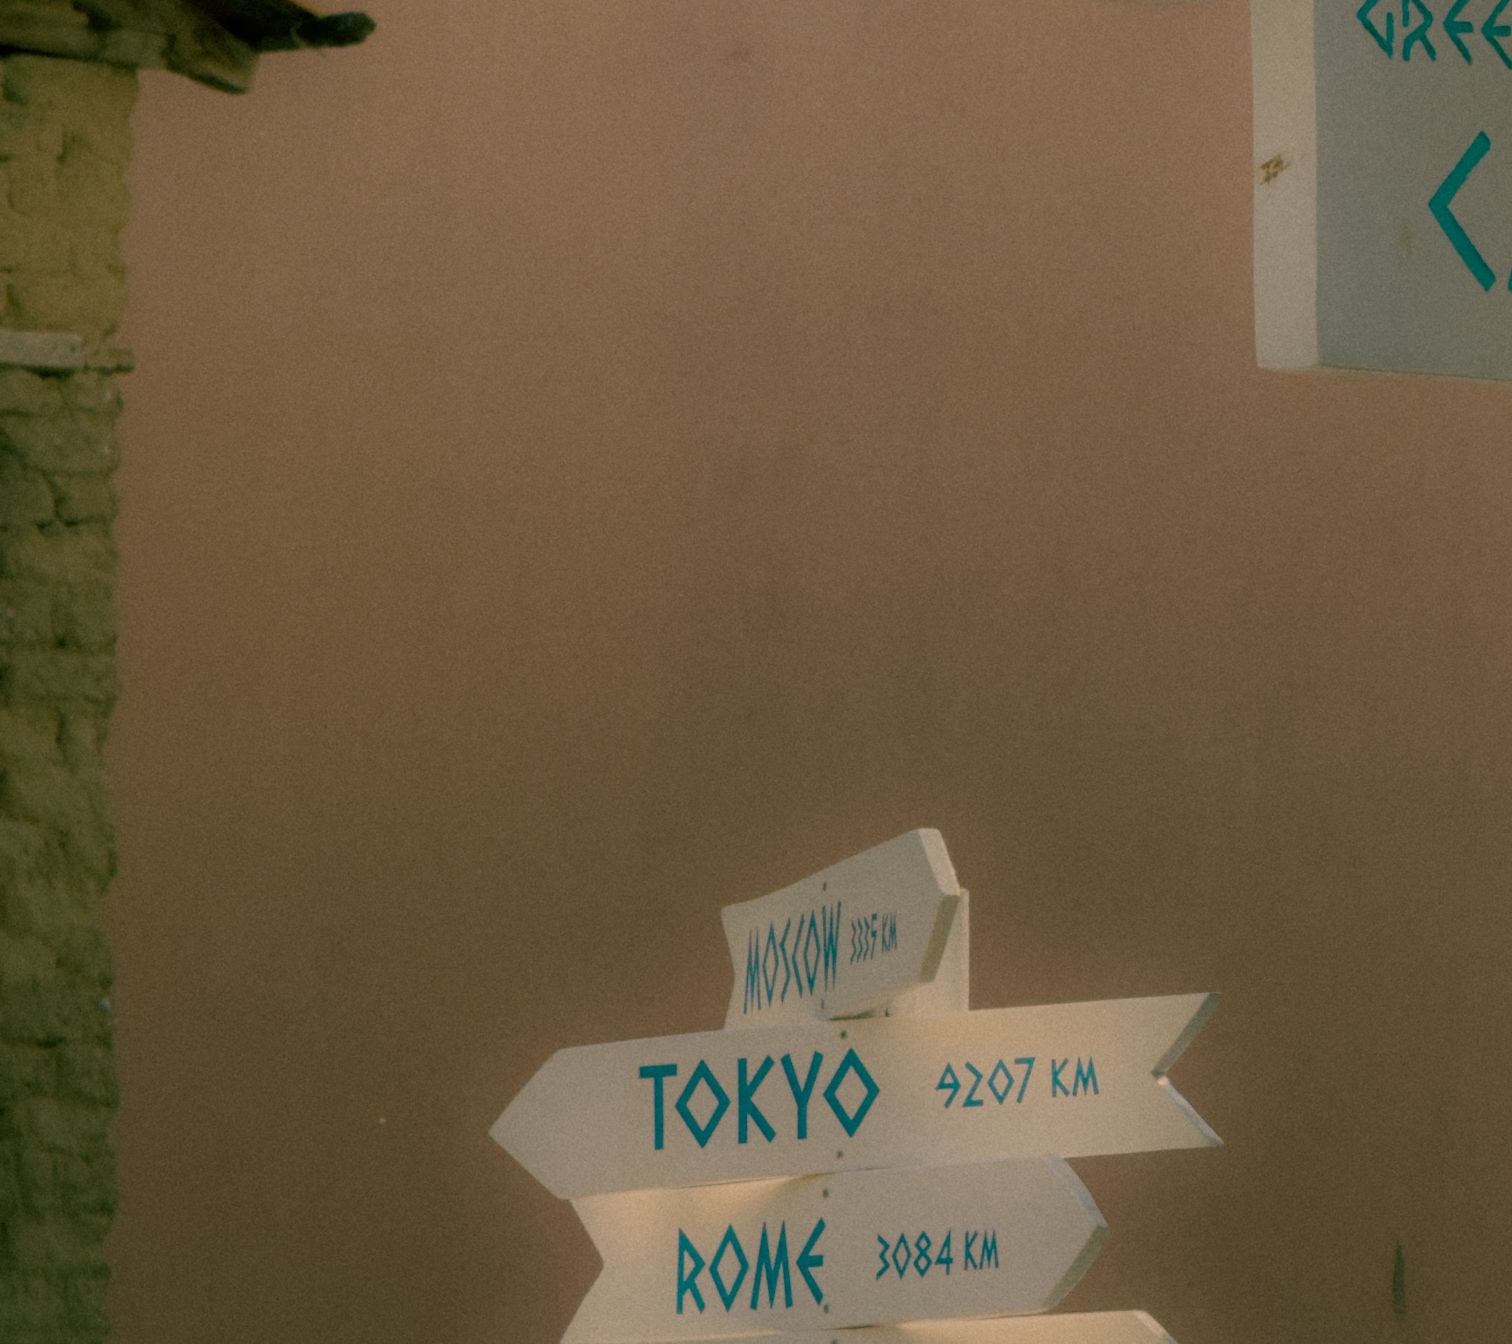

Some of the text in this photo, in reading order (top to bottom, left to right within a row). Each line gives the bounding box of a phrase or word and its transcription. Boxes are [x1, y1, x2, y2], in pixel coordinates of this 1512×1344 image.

[743, 900, 842, 1015] MOSCOW
[881, 911, 898, 953] KM
[638, 1048, 1100, 1151] TOKYO 9207 KM
[675, 1217, 1000, 1315] ROME 3084 KM
